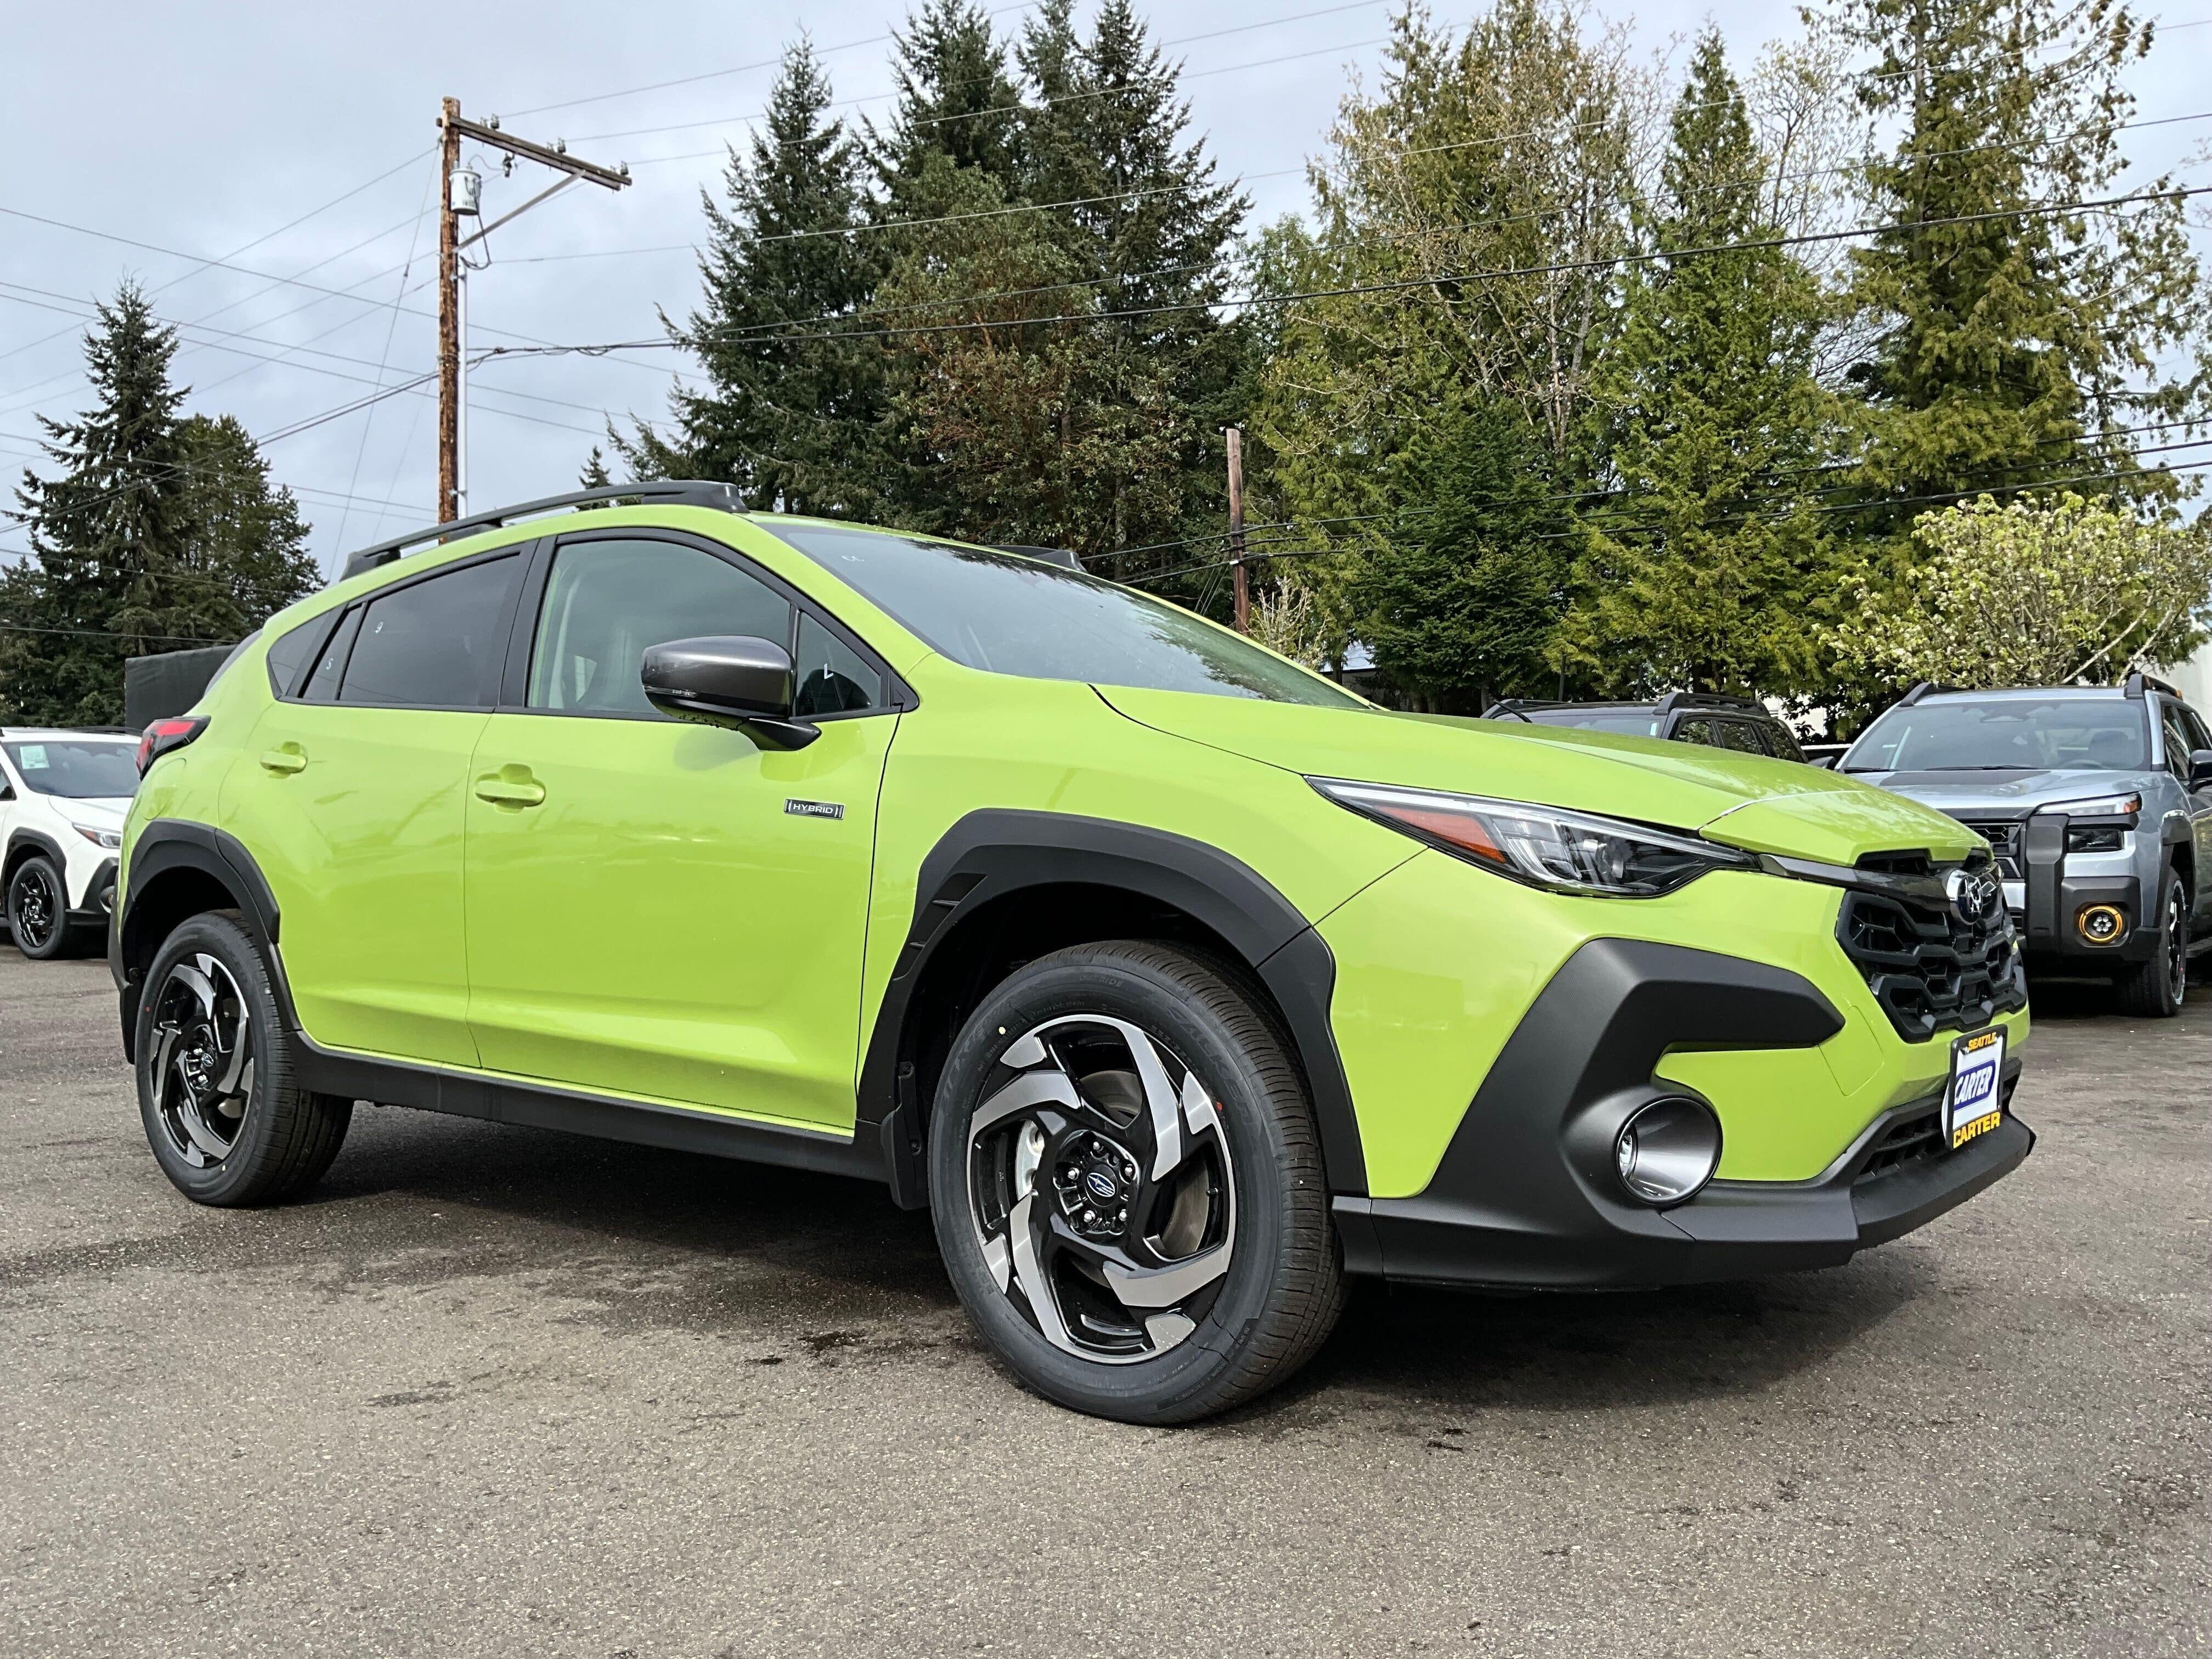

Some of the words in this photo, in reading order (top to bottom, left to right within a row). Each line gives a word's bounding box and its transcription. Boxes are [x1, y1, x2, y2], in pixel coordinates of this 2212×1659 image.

[793, 803, 833, 814] HYBRID
[1968, 1032, 1996, 1051] SEATTLE
[1954, 1065, 1993, 1106] CARTER
[1953, 1111, 2001, 1149] CARTER
